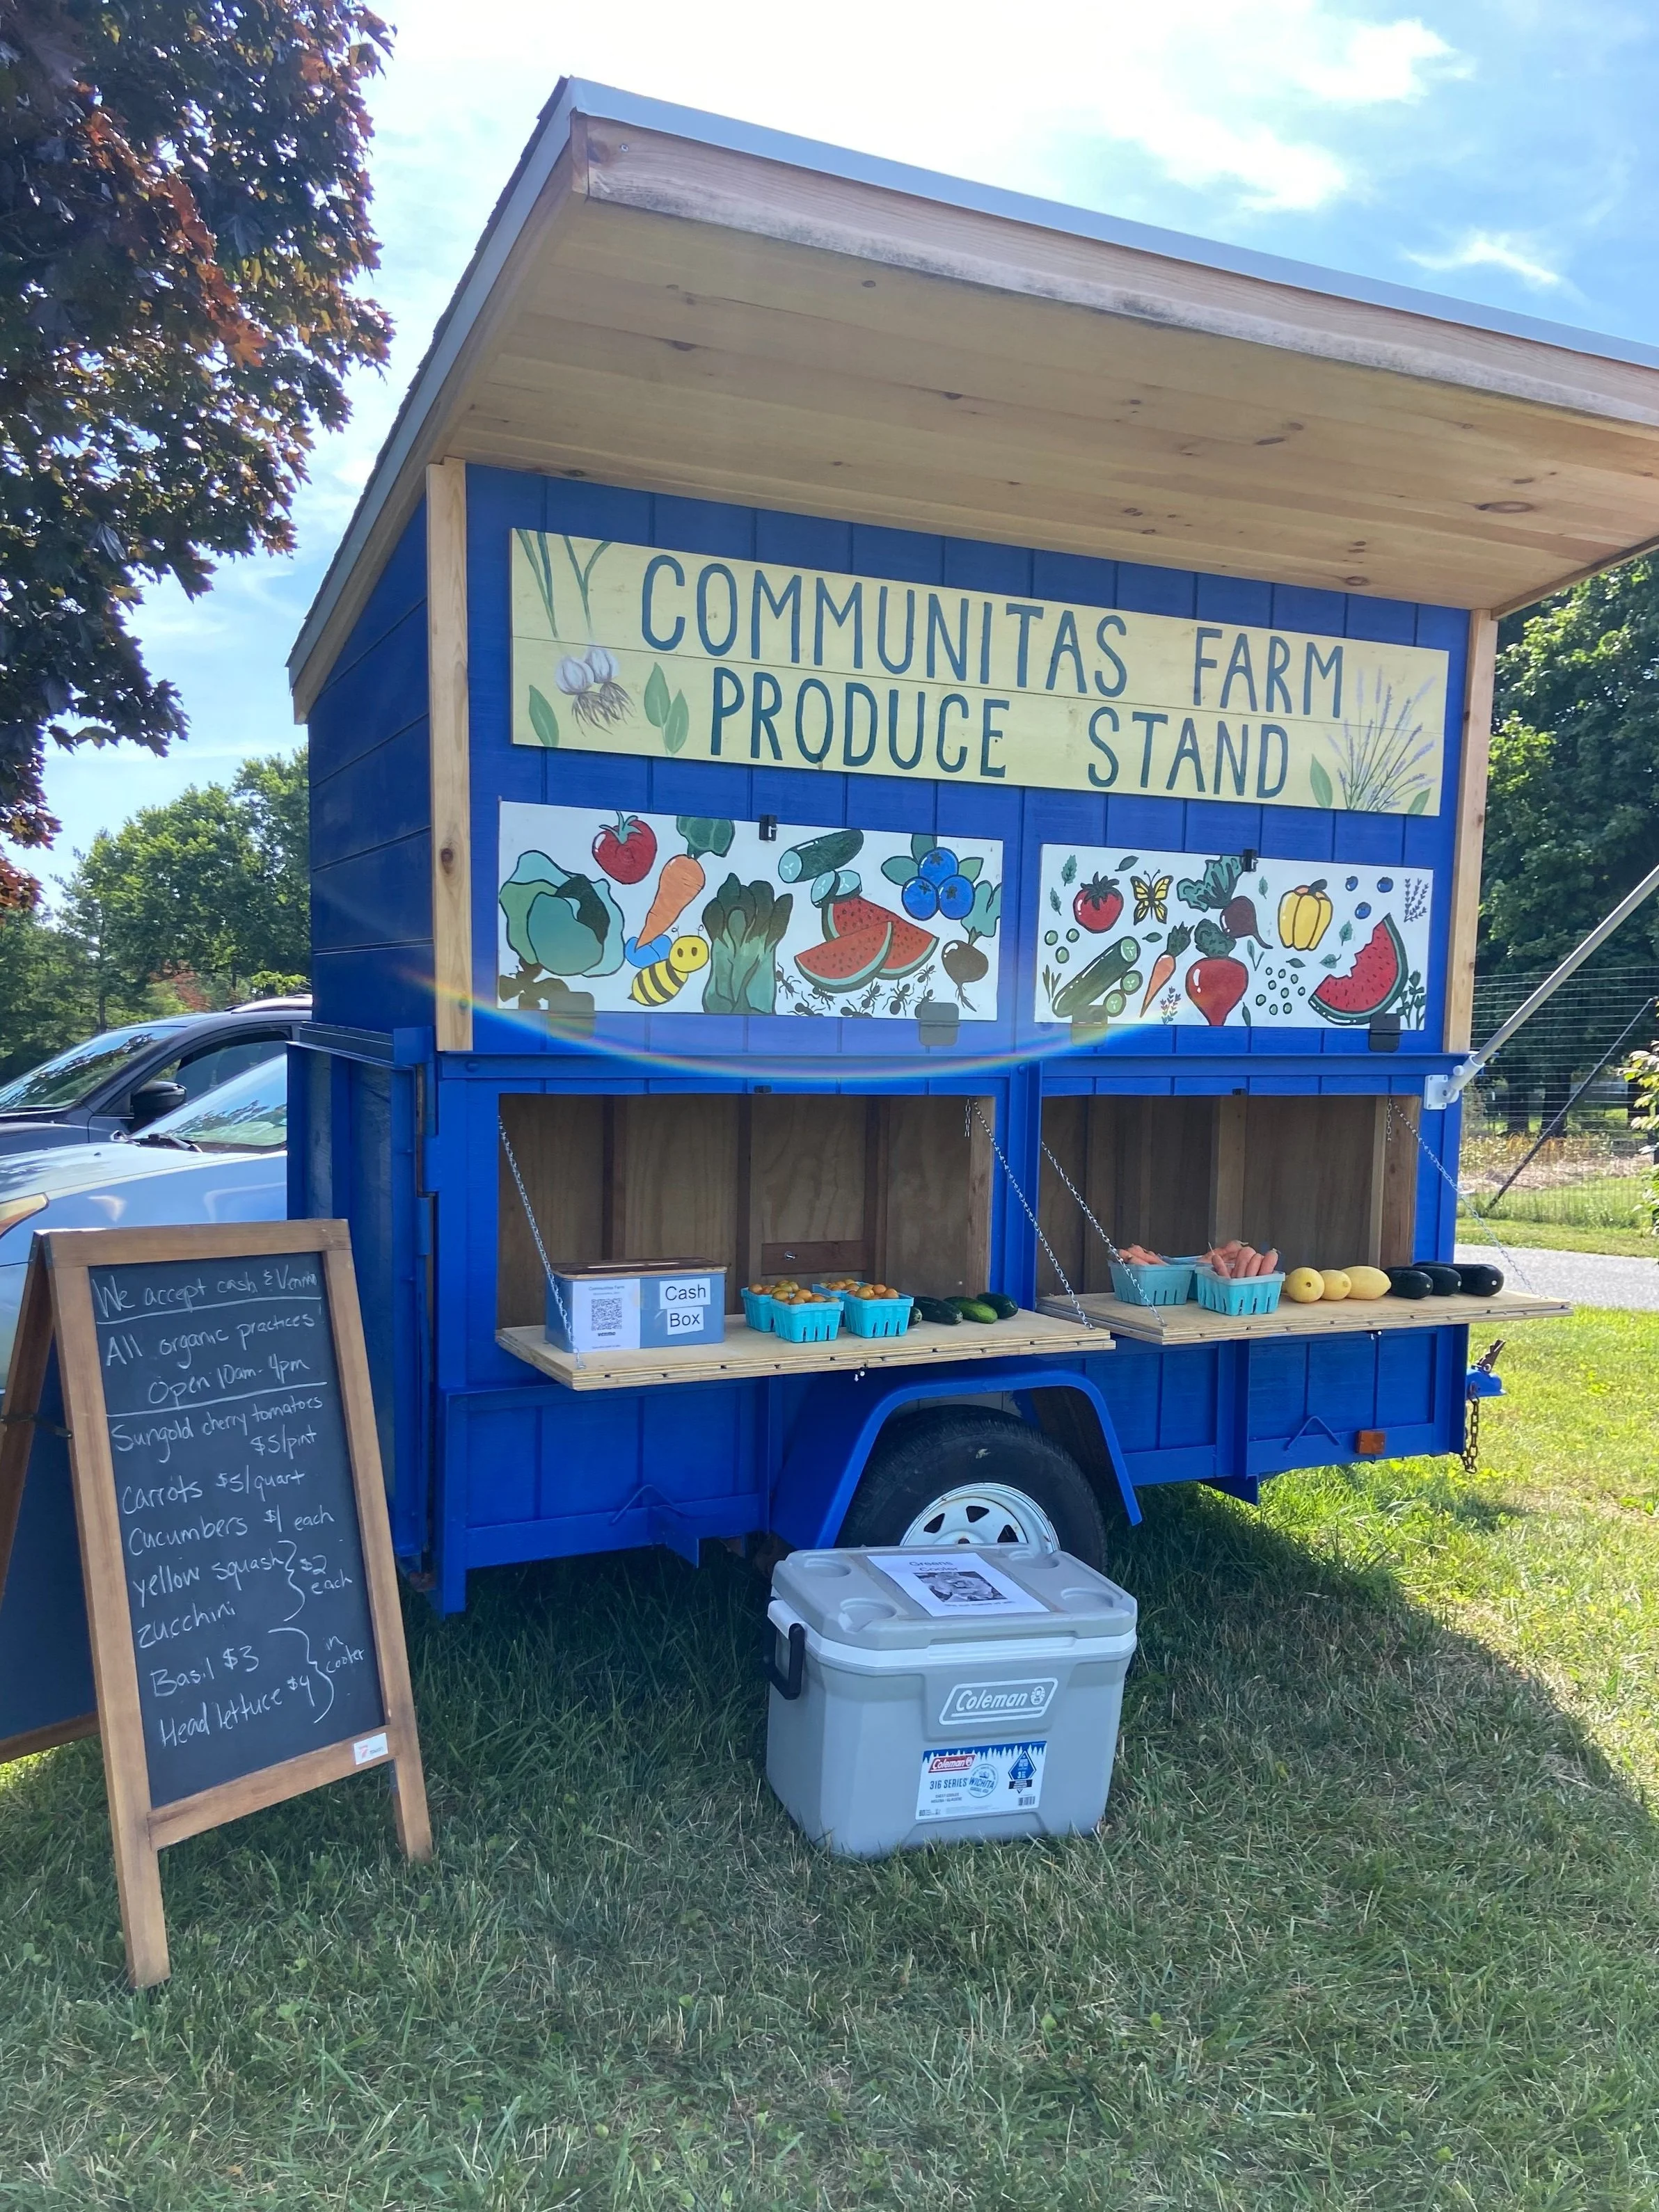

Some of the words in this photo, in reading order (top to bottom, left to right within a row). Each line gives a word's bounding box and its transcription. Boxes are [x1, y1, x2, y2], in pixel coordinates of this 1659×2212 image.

[641, 555, 1128, 698] COMMUNITAS
[1194, 628, 1344, 719] FARM
[711, 668, 1010, 778] PRODUCE
[1088, 706, 1288, 799] STAND
[93, 1275, 135, 1317] We
[145, 1279, 205, 1312] accept
[217, 1271, 256, 1294] cash
[665, 1284, 706, 1301] Cash
[669, 1312, 701, 1328] Box
[106, 1334, 143, 1366] All
[159, 1328, 229, 1369] organic
[237, 1313, 315, 1350] practices
[148, 1374, 210, 1410] Open
[111, 1417, 194, 1463] Sungold
[202, 1413, 247, 1437] cherry
[251, 1395, 324, 1424] tomatoes
[251, 1425, 317, 1460] $5/pint
[216, 1465, 305, 1502] $5/quart
[129, 1515, 248, 1556] Cucumbers
[264, 1504, 282, 1532] $1
[294, 1505, 335, 1531] each
[212, 1549, 285, 1591] squash
[300, 1555, 327, 1575] $2
[310, 1570, 353, 1595] each
[324, 1636, 344, 1650] in
[326, 1646, 365, 1673] cooler
[150, 1657, 214, 1697] Basil
[223, 1646, 260, 1672] $3
[160, 1703, 210, 1747] Head
[218, 1687, 283, 1730] lettuce
[287, 1676, 315, 1708] $4
[955, 1689, 1028, 1712] Coleman
[932, 1758, 965, 1770] Coleman
[930, 1780, 942, 1790] 316
[944, 1778, 968, 1788] SERIES
[969, 1776, 995, 1790] WICHITA
